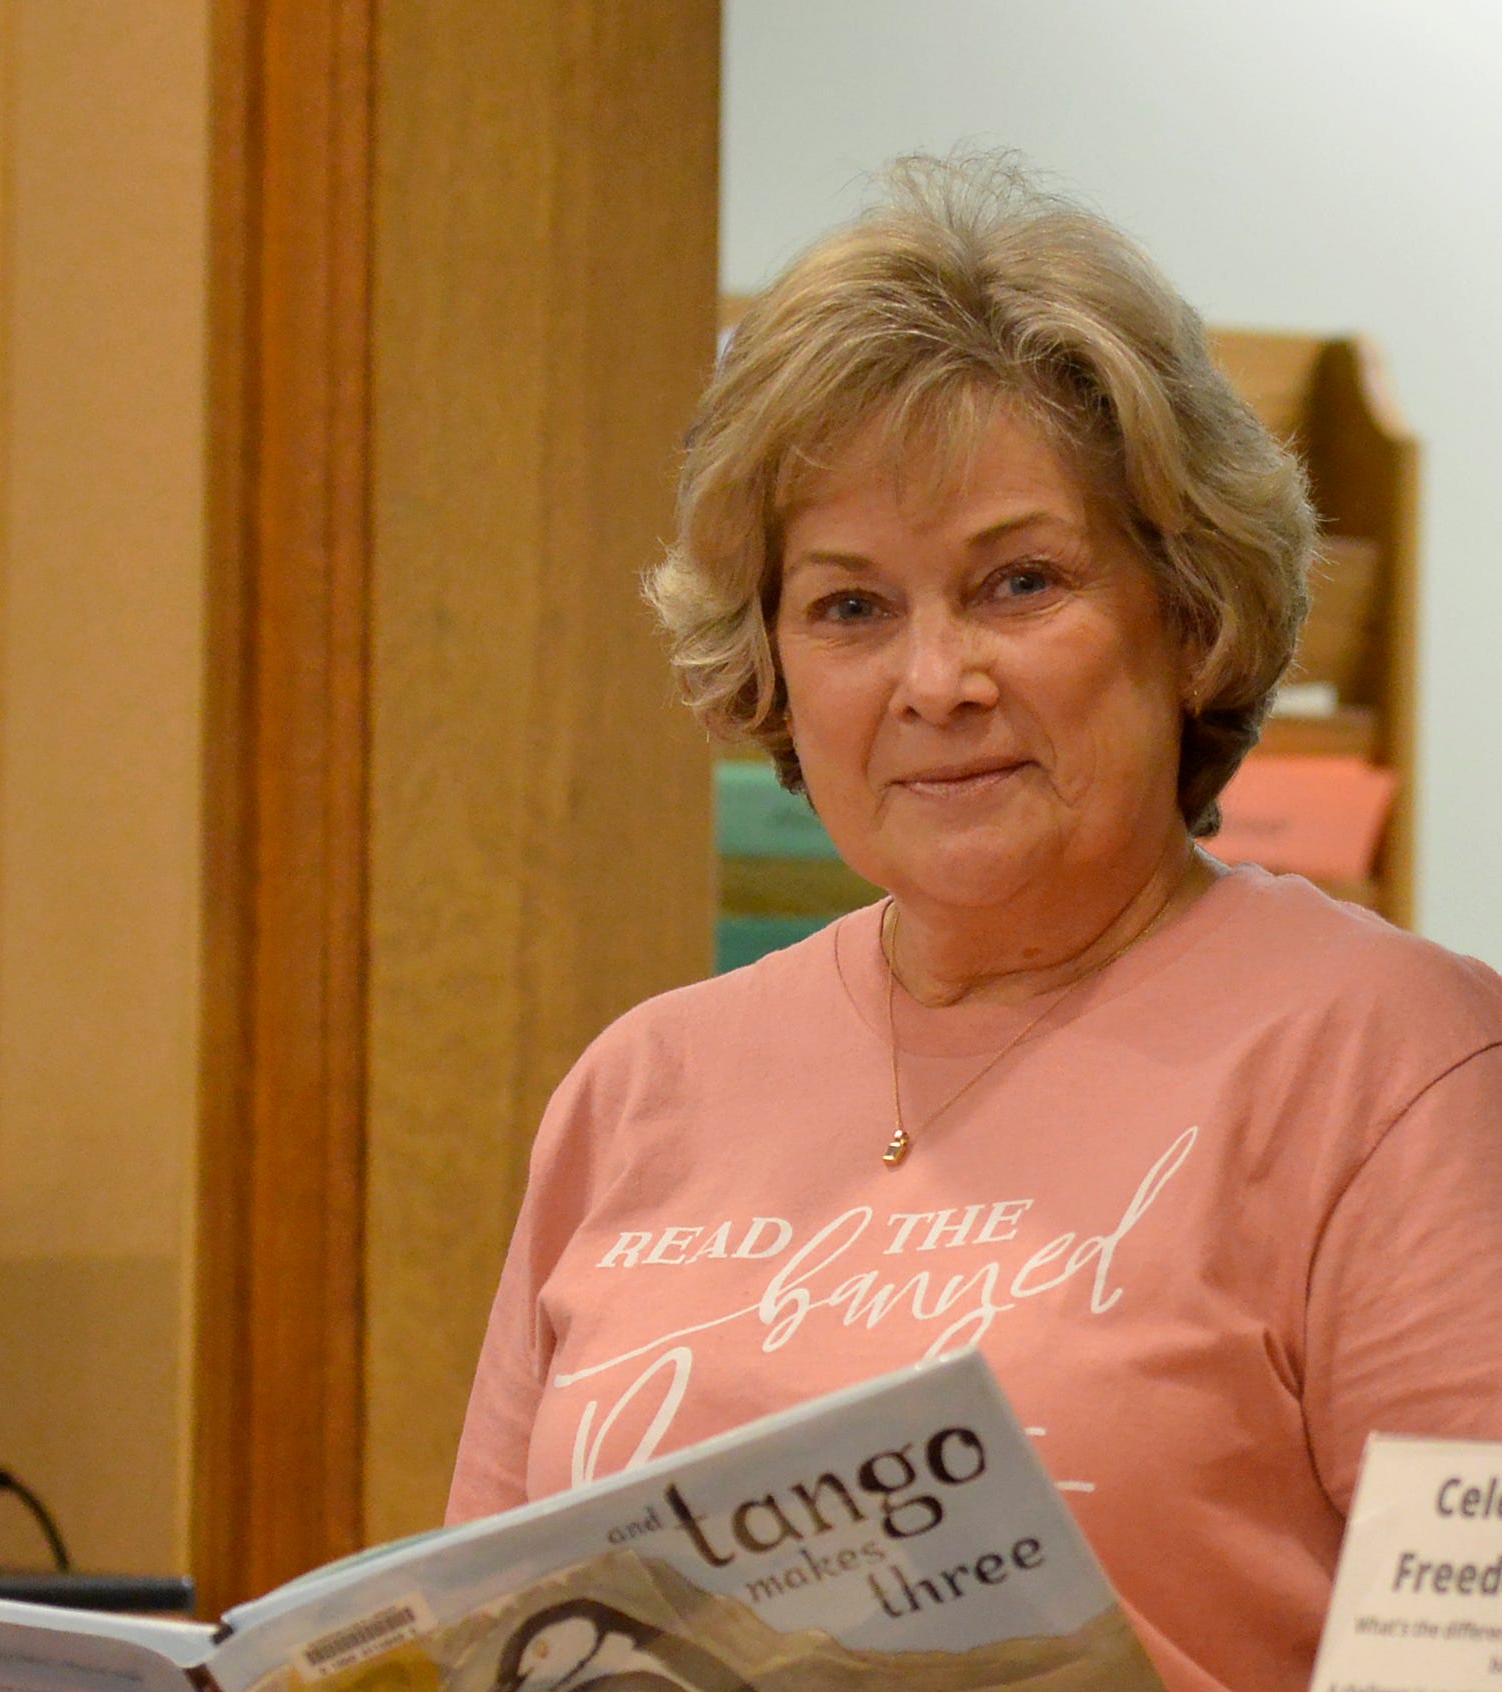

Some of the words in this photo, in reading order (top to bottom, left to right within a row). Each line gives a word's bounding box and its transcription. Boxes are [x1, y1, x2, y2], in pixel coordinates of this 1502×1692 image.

[595, 1215, 795, 1269] READ
[882, 1198, 1034, 1256] THE
[759, 1125, 1199, 1354] banned
[607, 1505, 662, 1546] and
[661, 1425, 989, 1569] tango
[745, 1539, 886, 1604] makes
[866, 1534, 1045, 1620] three
